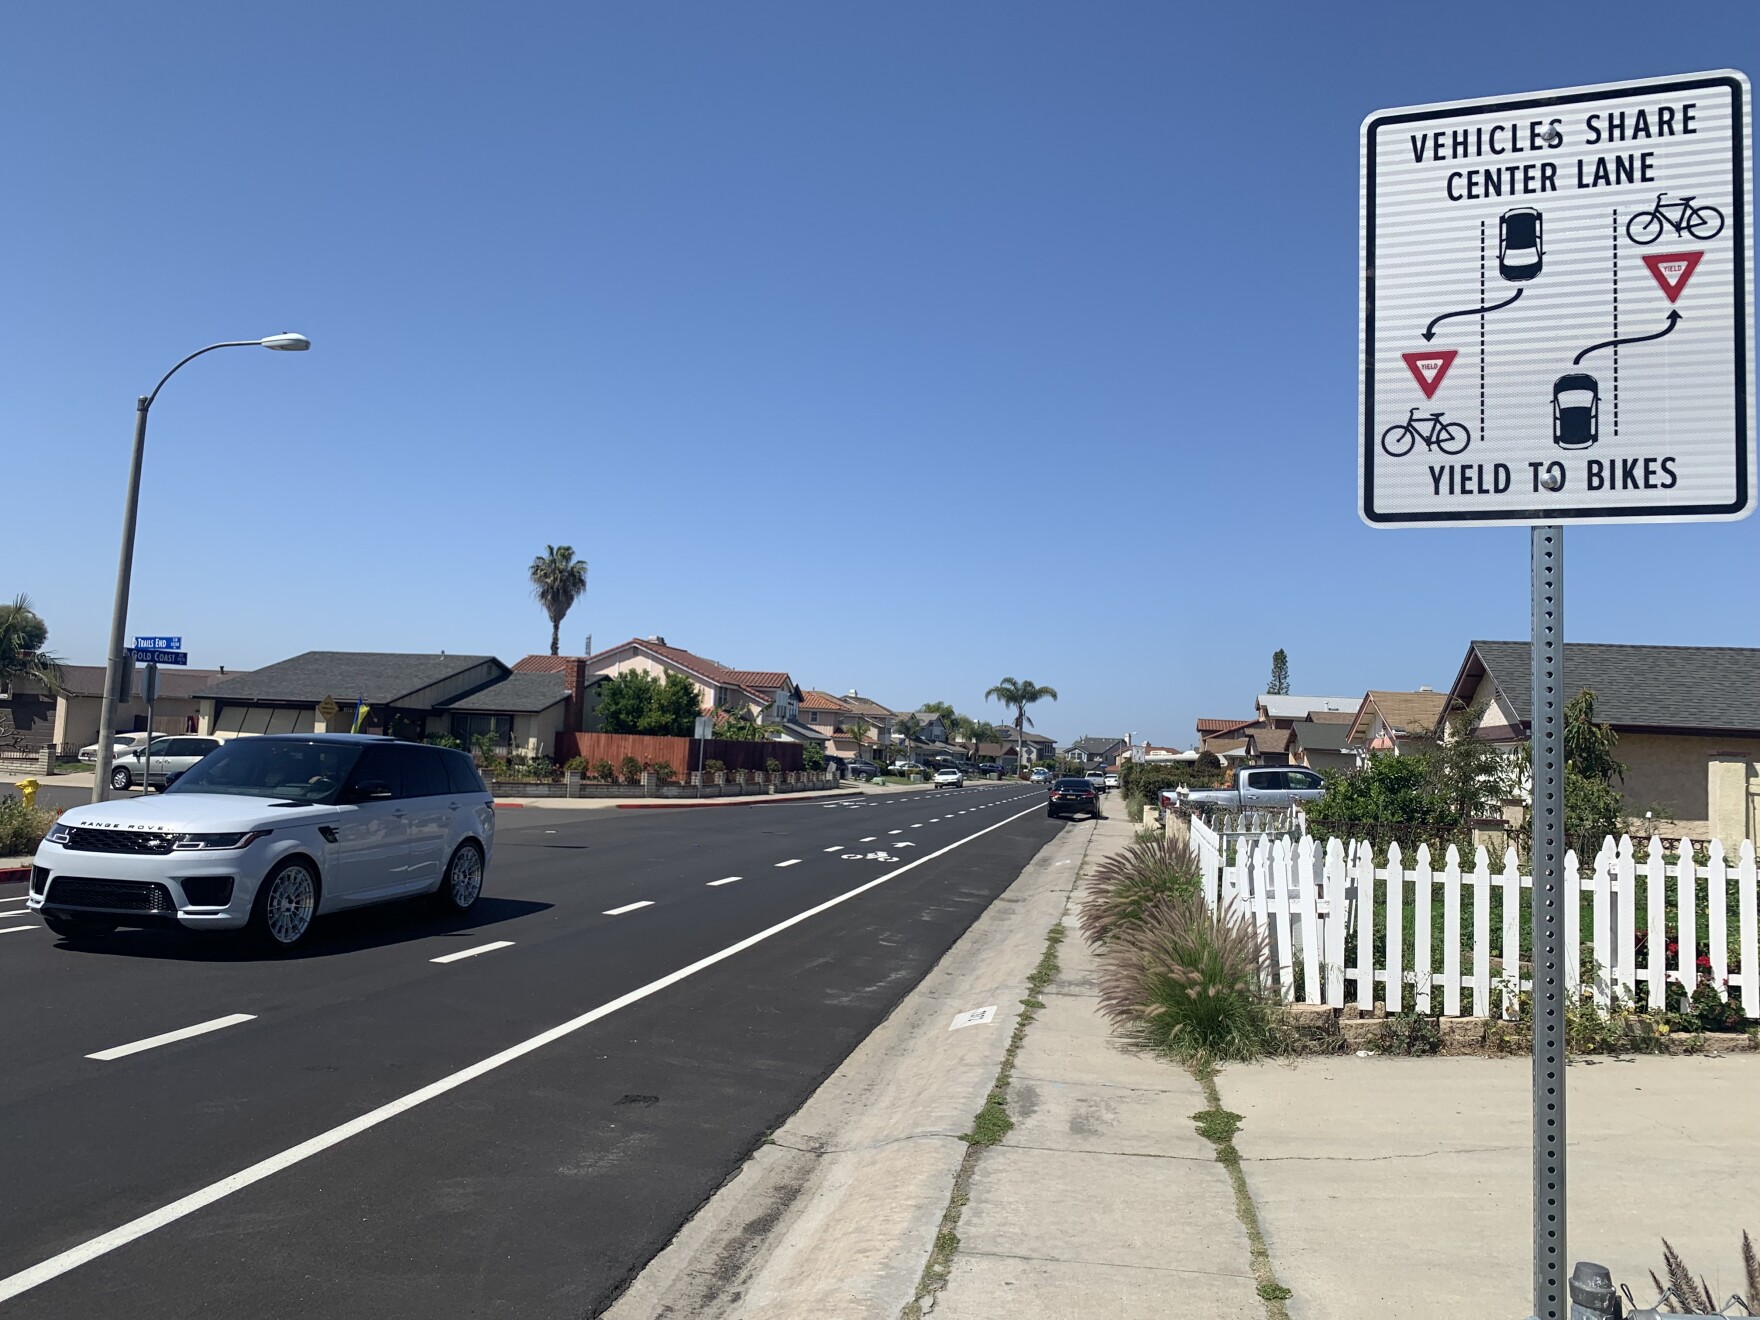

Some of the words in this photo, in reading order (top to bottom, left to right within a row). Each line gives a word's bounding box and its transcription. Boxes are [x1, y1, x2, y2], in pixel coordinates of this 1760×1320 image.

[1411, 118, 1563, 163] VEHICLES
[1586, 103, 1697, 145] SHARE
[1446, 162, 1558, 201] CENTER
[1577, 151, 1655, 189] LANE
[1663, 264, 1683, 272] YIELD
[1420, 362, 1439, 370] YIELD
[1428, 462, 1511, 496] YIELD
[1528, 461, 1567, 493] TO
[1586, 456, 1677, 491] BIKES
[138, 638, 154, 648] TRAILS
[155, 638, 167, 648] END
[131, 650, 152, 660] GOLD
[154, 652, 175, 662] COAST
[80, 820, 120, 829] RANGE
[127, 824, 174, 832] ROVE
